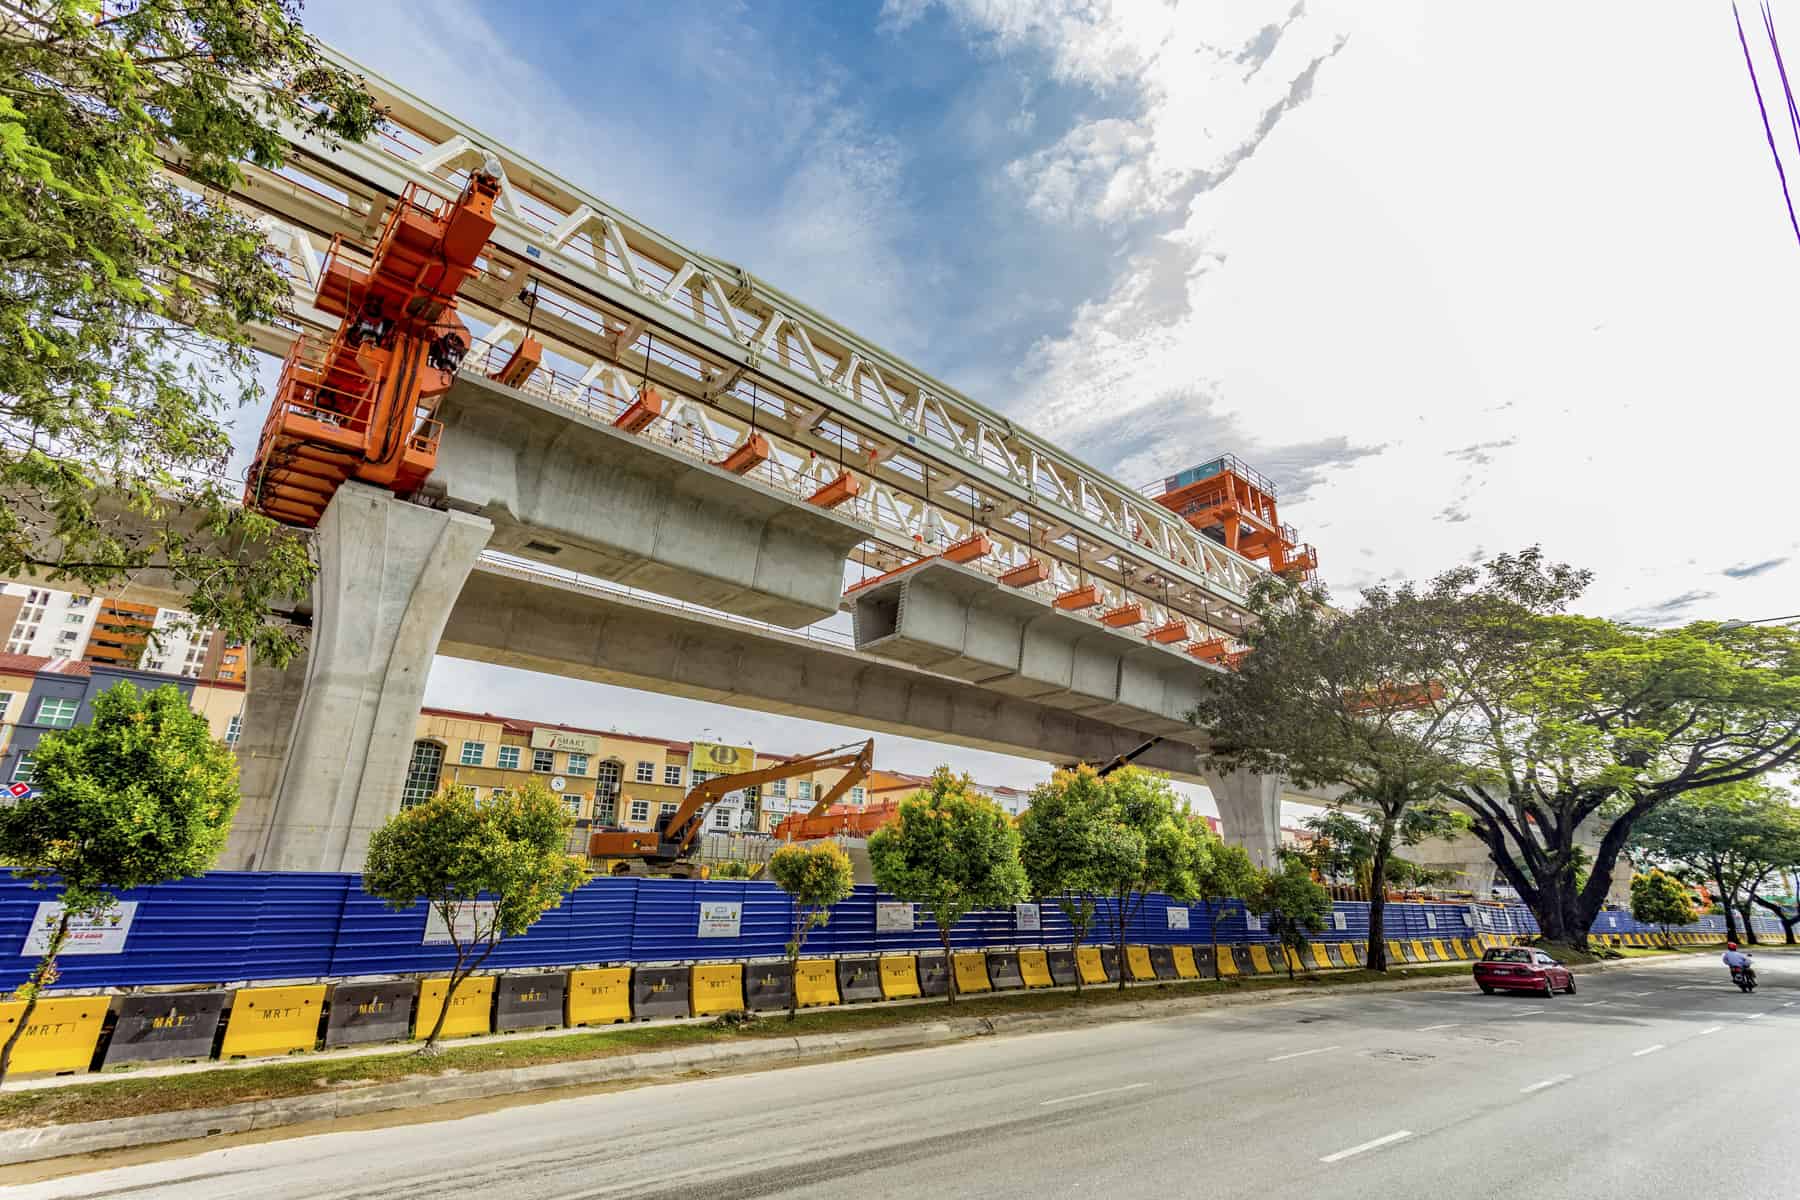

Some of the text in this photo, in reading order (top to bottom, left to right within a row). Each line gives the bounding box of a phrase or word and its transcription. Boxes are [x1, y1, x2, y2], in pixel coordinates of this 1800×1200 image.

[264, 1008, 291, 1019] MRT
[359, 1002, 384, 1014] MRT
[152, 1015, 185, 1029] MRT
[26, 1023, 63, 1036] MRT
